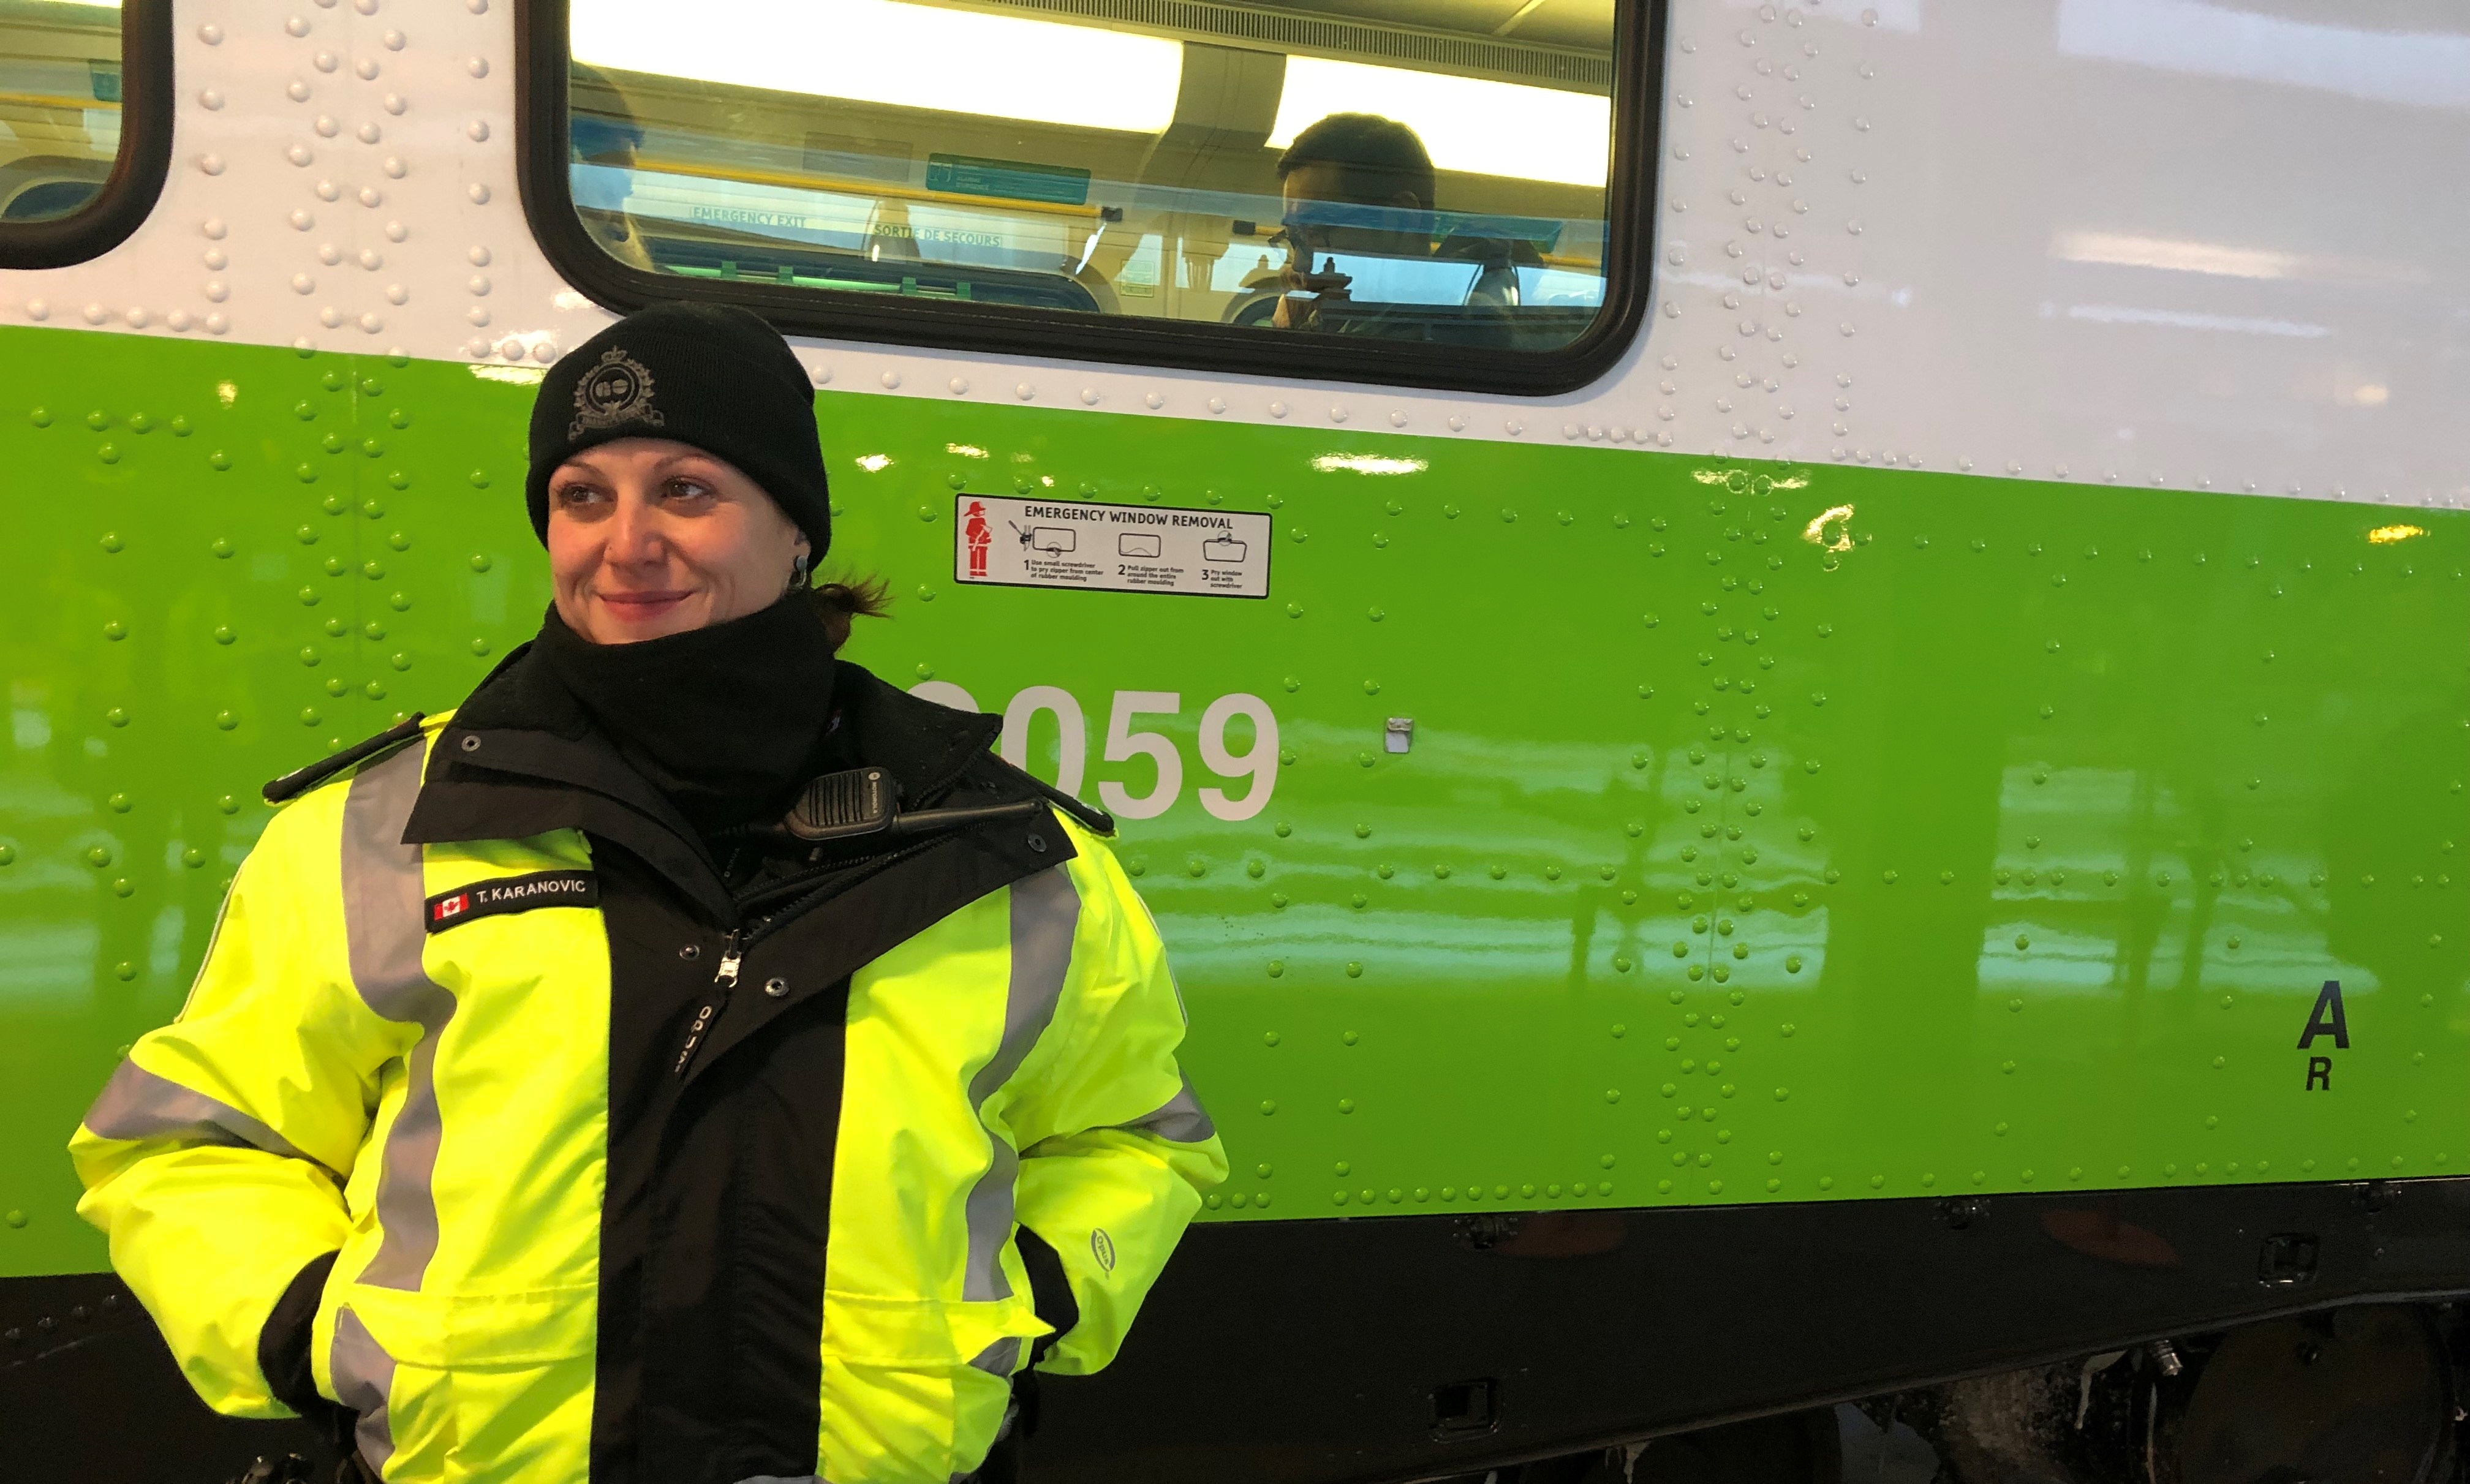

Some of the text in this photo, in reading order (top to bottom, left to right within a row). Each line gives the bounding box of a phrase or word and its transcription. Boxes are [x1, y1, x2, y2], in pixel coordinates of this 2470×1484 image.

[693, 207, 806, 228] EMERGENCY EXIT
[874, 224, 1000, 246] SORTIE DE SECOURS
[1025, 505, 1233, 530] EMERGENCY WINDOW REMOVAL
[1024, 559, 1029, 570] 1
[1118, 564, 1125, 575] 2
[1201, 569, 1209, 581] 3
[907, 680, 1279, 822] 059
[477, 879, 586, 903] T. KARANOVIC
[2297, 980, 2350, 1049] A
[2305, 1056, 2332, 1091] R
